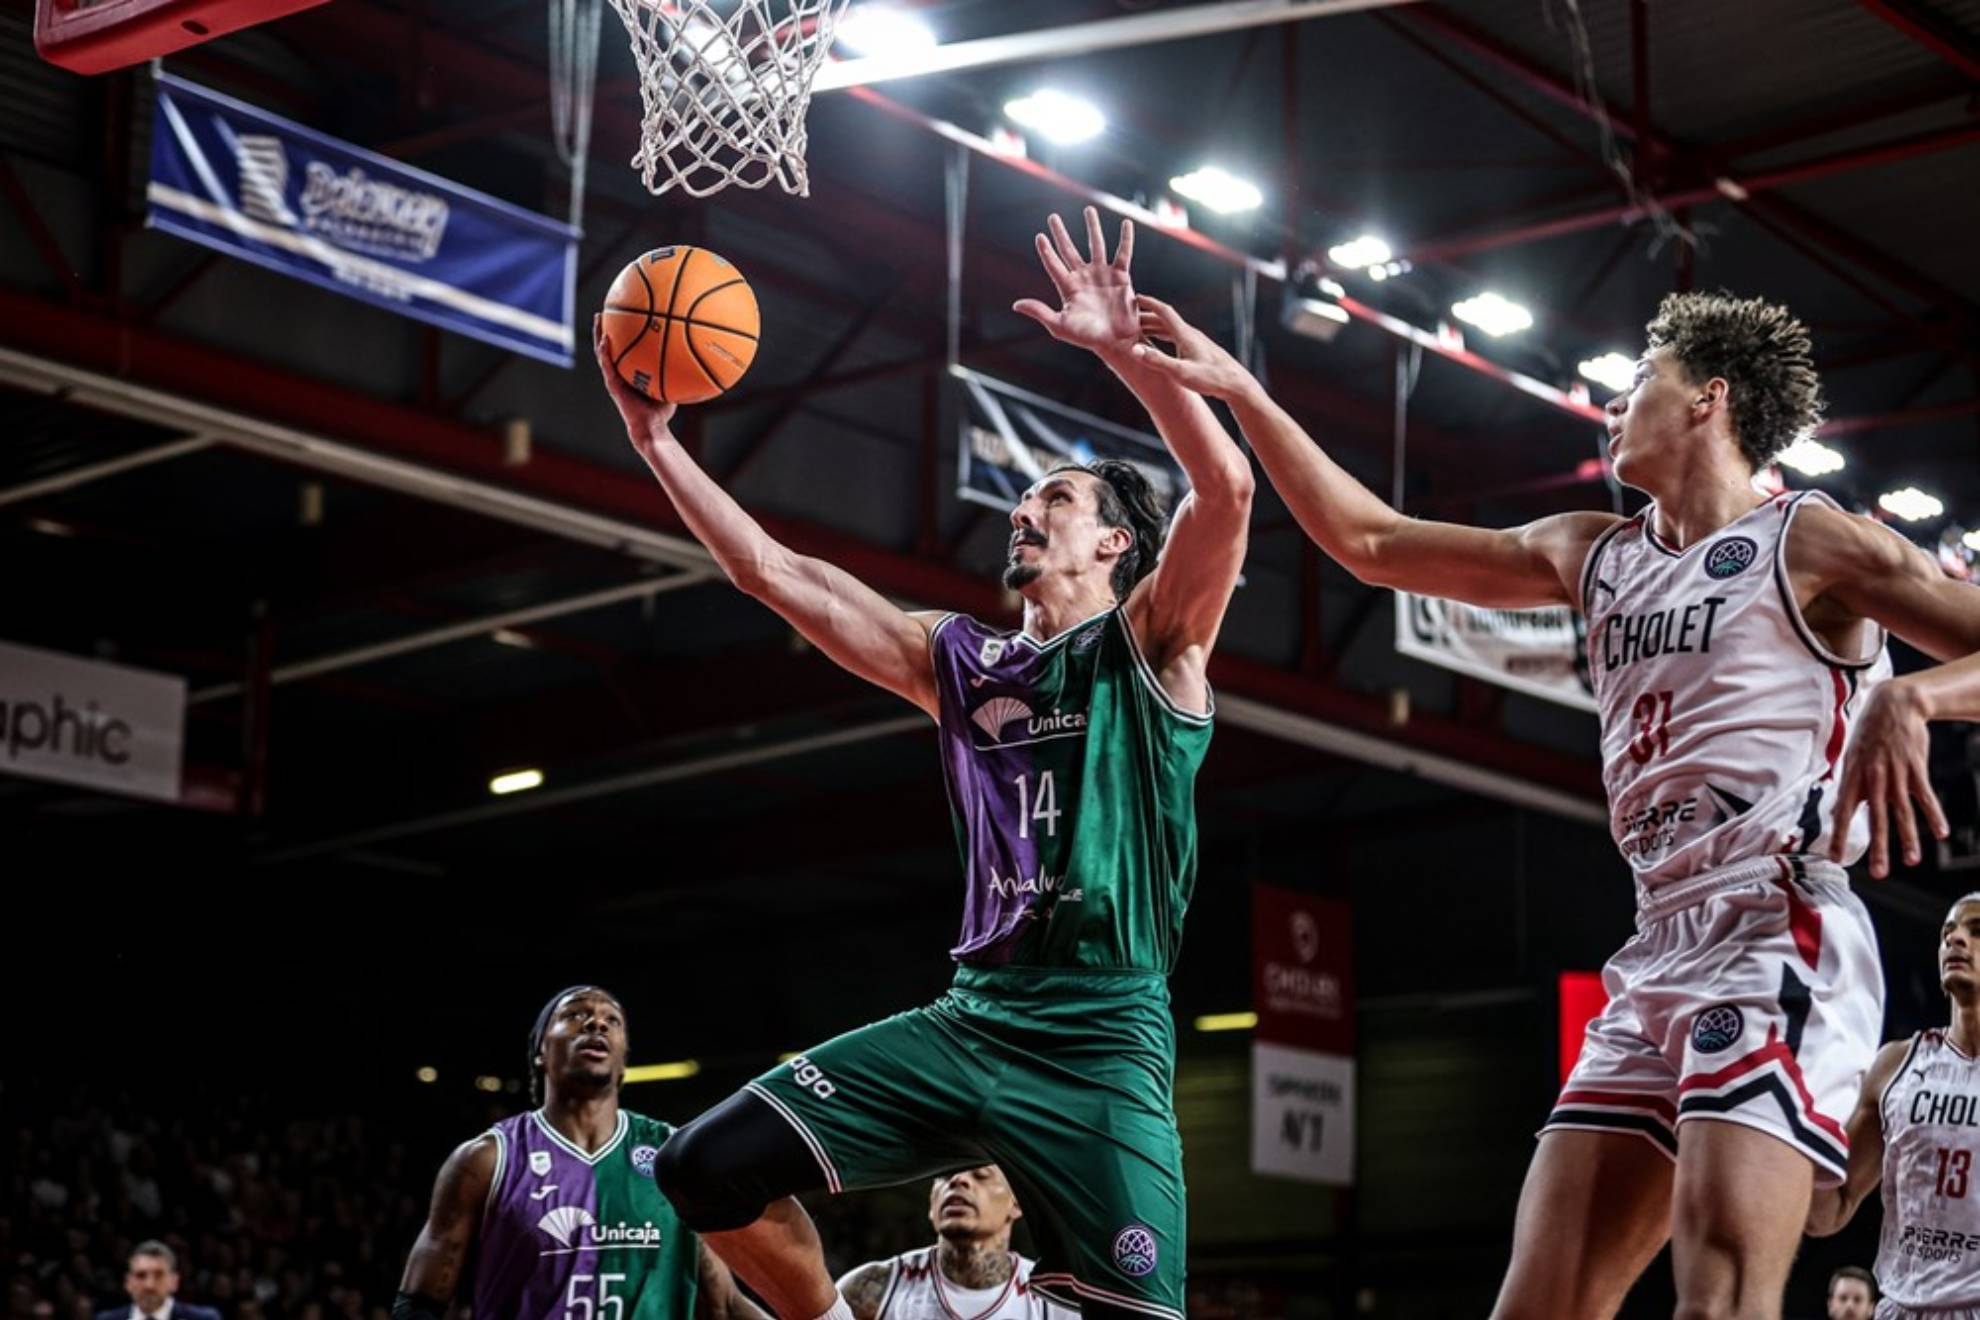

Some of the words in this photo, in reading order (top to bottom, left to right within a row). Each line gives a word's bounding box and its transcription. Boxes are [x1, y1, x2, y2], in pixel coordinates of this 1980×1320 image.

[1604, 597, 1726, 671] CHOLET
[0, 693, 132, 765] phic
[1028, 707, 1089, 735] Unica
[1629, 690, 1674, 765] 31
[1015, 770, 1062, 838] 14
[1910, 1090, 1978, 1127] CHOL
[1935, 1147, 1971, 1199] 13
[591, 1221, 661, 1245] Unicaja
[564, 1273, 626, 1320] 55
